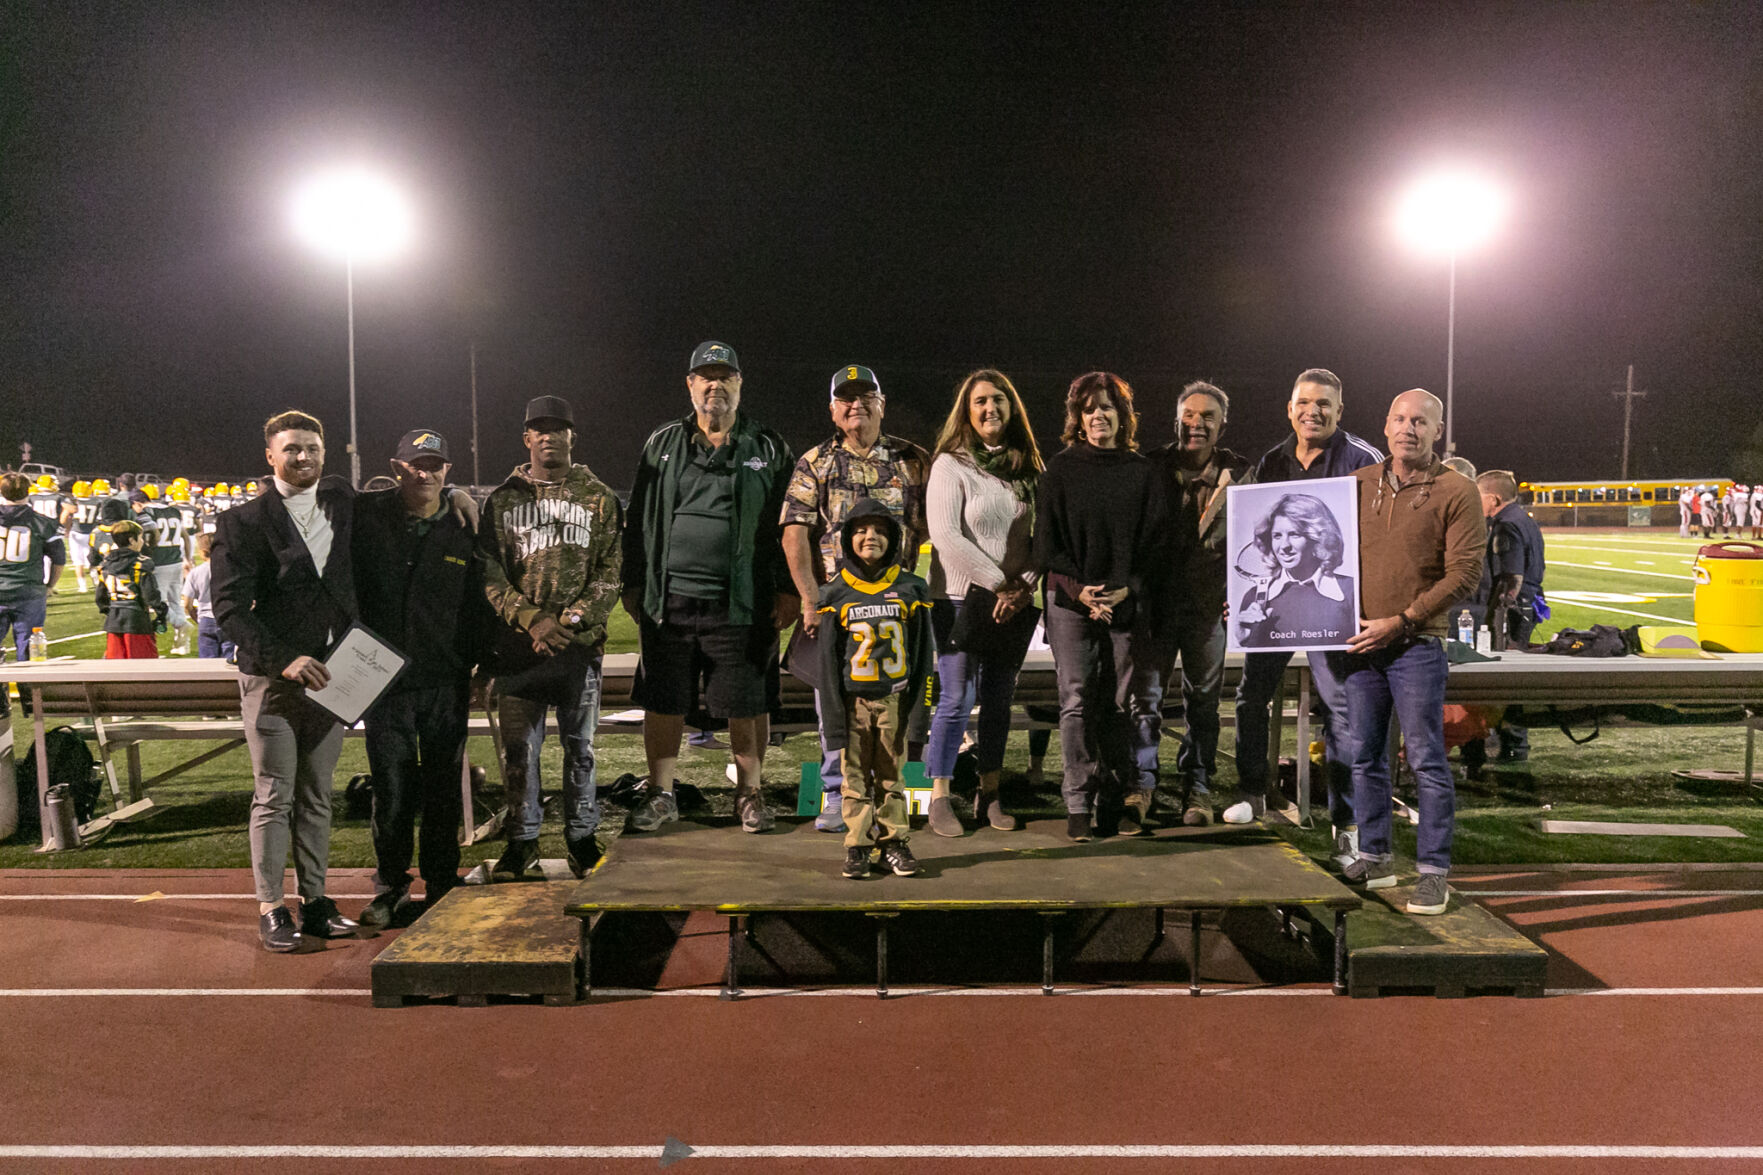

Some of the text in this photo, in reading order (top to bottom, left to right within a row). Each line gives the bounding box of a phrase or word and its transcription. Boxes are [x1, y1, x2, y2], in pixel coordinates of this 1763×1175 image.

[847, 366, 858, 380] 3
[503, 498, 594, 534] BILLIONAIRE
[848, 603, 901, 620] ARGONAUT
[1270, 629, 1340, 640] Coach Roesler
[848, 620, 907, 682] 23
